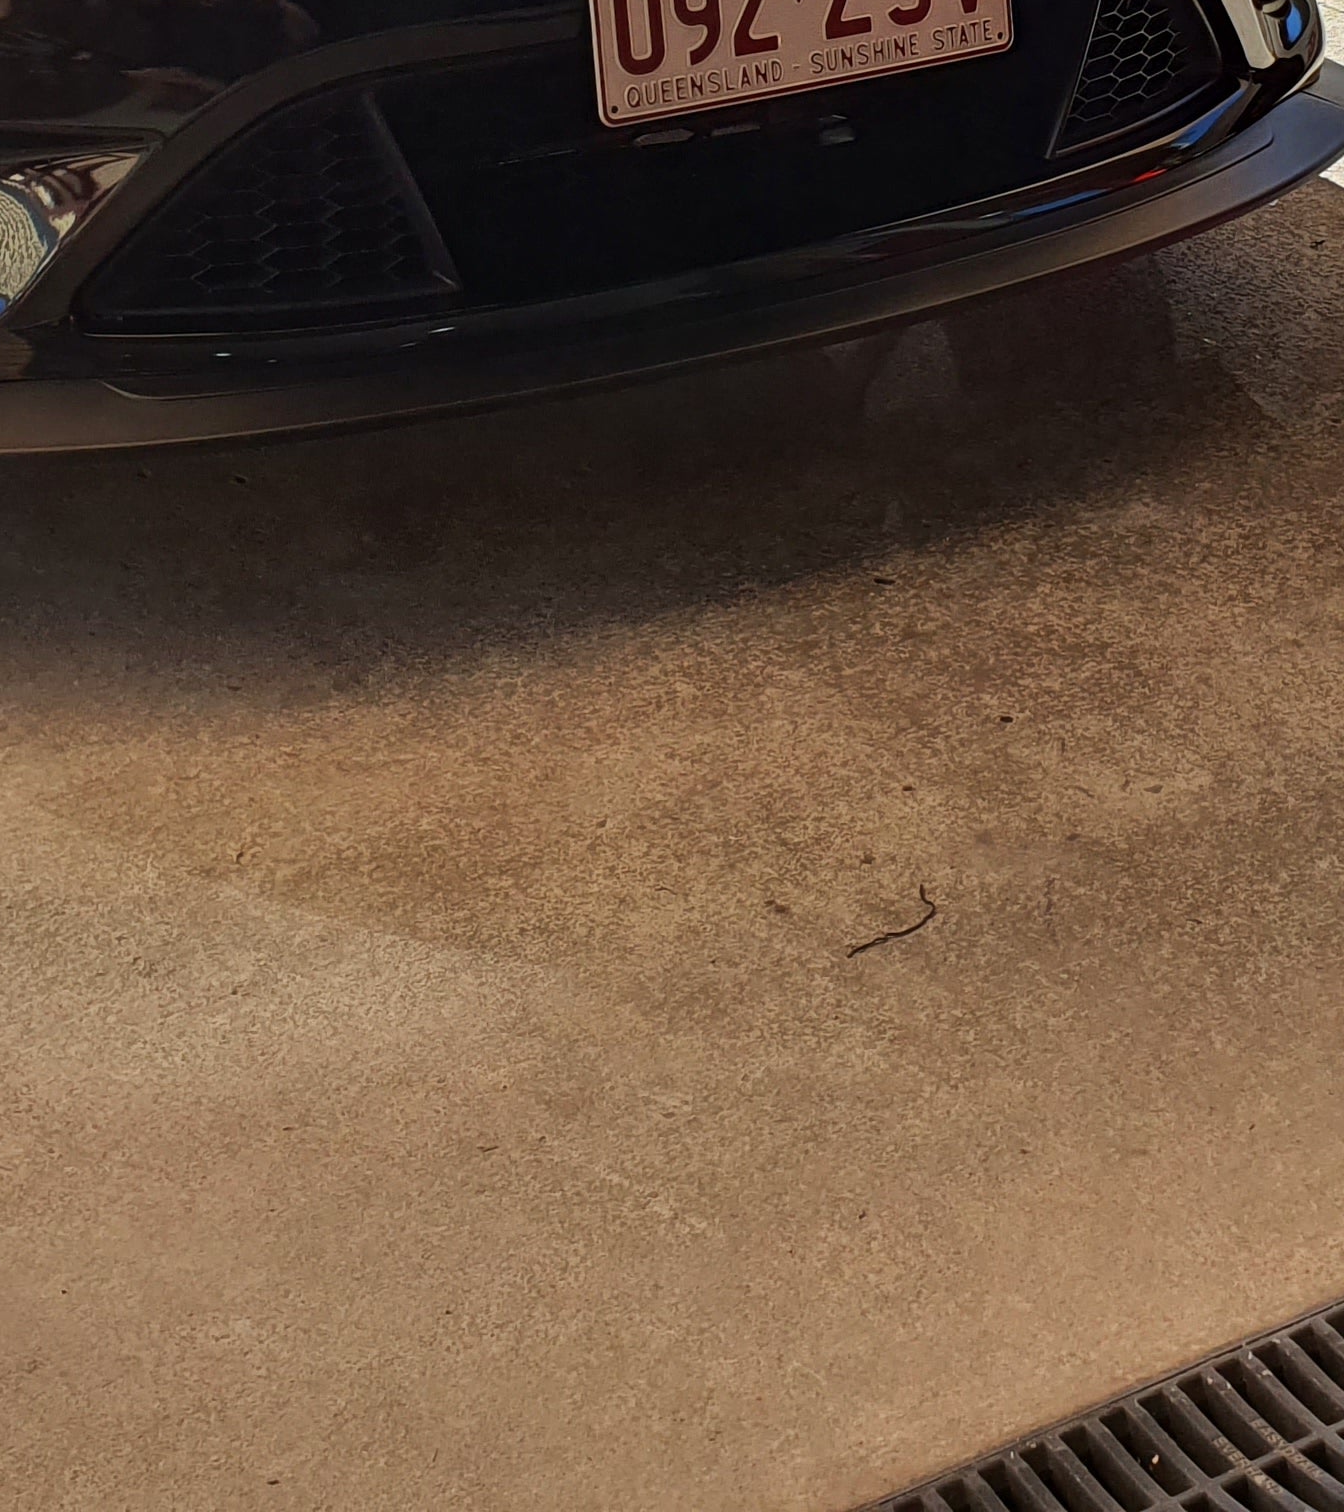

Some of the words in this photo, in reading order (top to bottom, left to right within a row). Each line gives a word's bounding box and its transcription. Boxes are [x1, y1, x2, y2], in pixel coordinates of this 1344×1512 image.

[625, 59, 783, 109] QUEENSLAND
[810, 33, 920, 74] SUNSHINE
[931, 19, 993, 51] STATE
